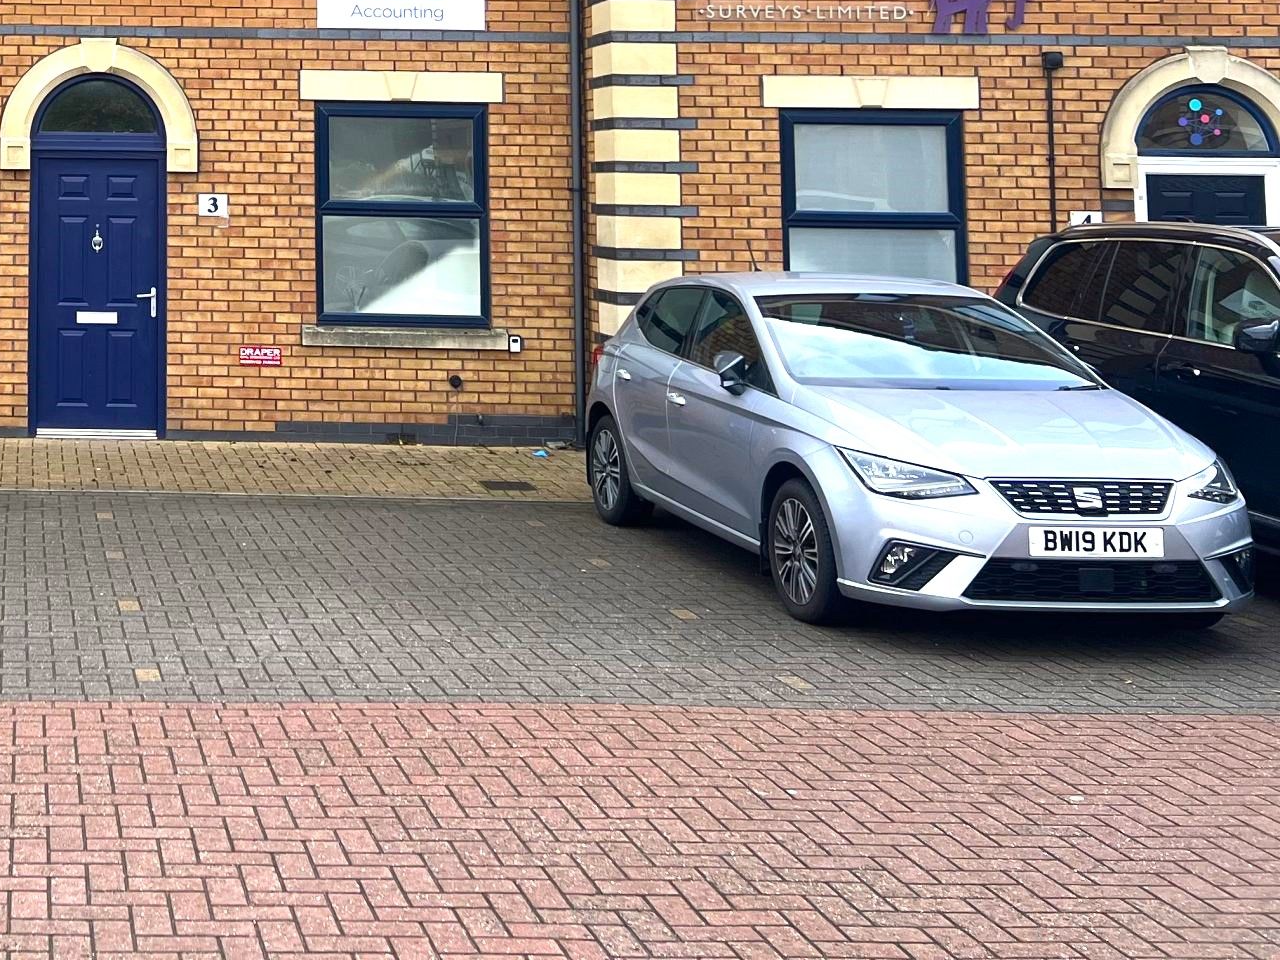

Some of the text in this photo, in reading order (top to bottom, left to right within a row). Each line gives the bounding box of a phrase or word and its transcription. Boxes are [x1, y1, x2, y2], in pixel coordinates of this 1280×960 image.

[350, 4, 444, 22] Accounting
[706, 4, 907, 20] SURVEYS LIMITED
[207, 196, 219, 213] 3
[240, 347, 281, 356] DRAPER
[1043, 530, 1148, 553] BW19 KDK
